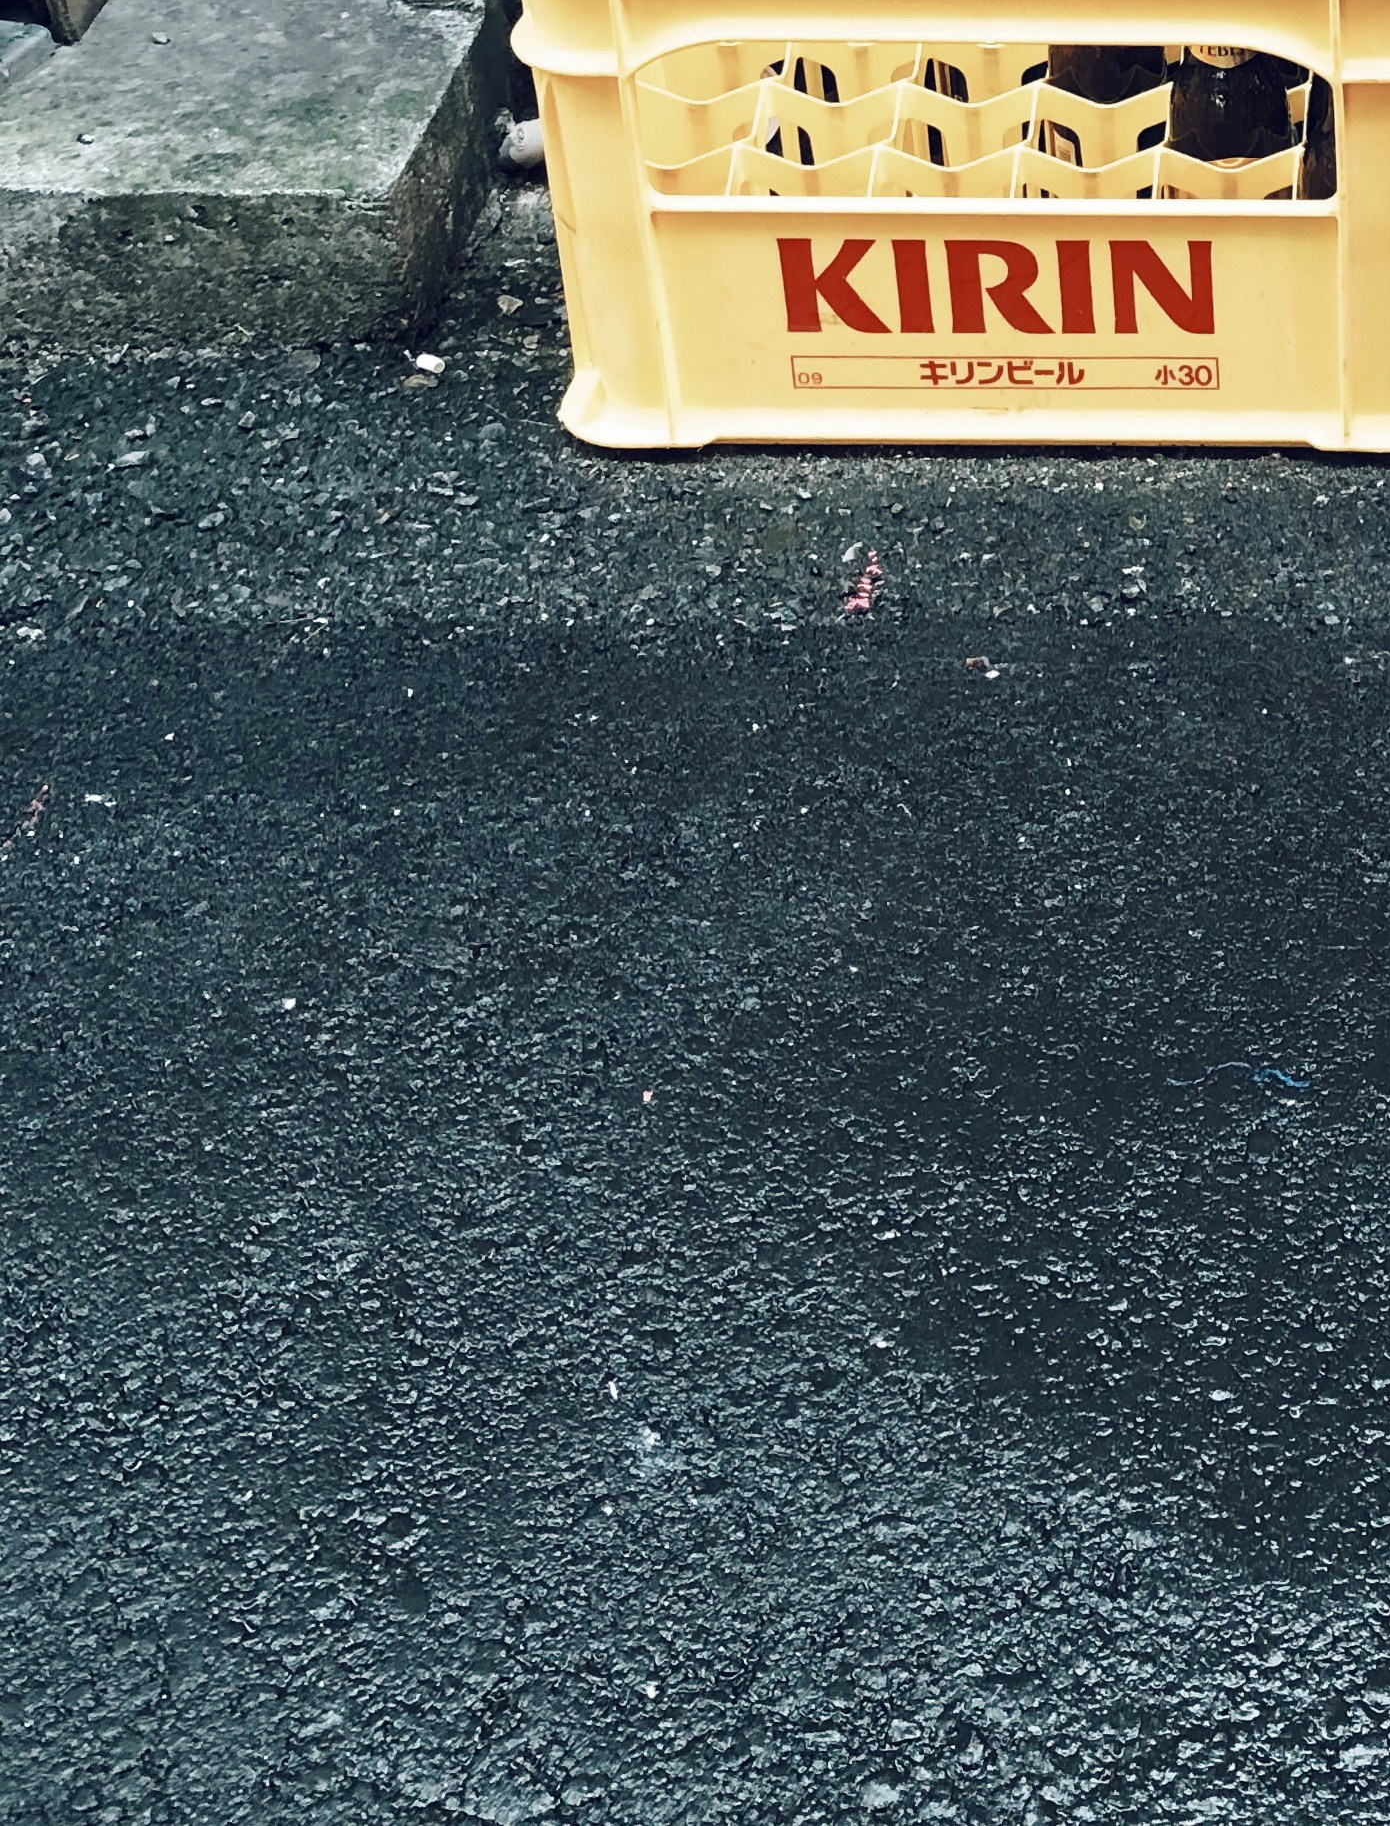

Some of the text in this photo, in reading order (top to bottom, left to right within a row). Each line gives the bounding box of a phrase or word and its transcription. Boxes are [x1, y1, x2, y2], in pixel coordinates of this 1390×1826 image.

[776, 238, 1215, 334] KIRIN
[798, 372, 822, 384] 09
[919, 361, 1085, 385] キリンビール
